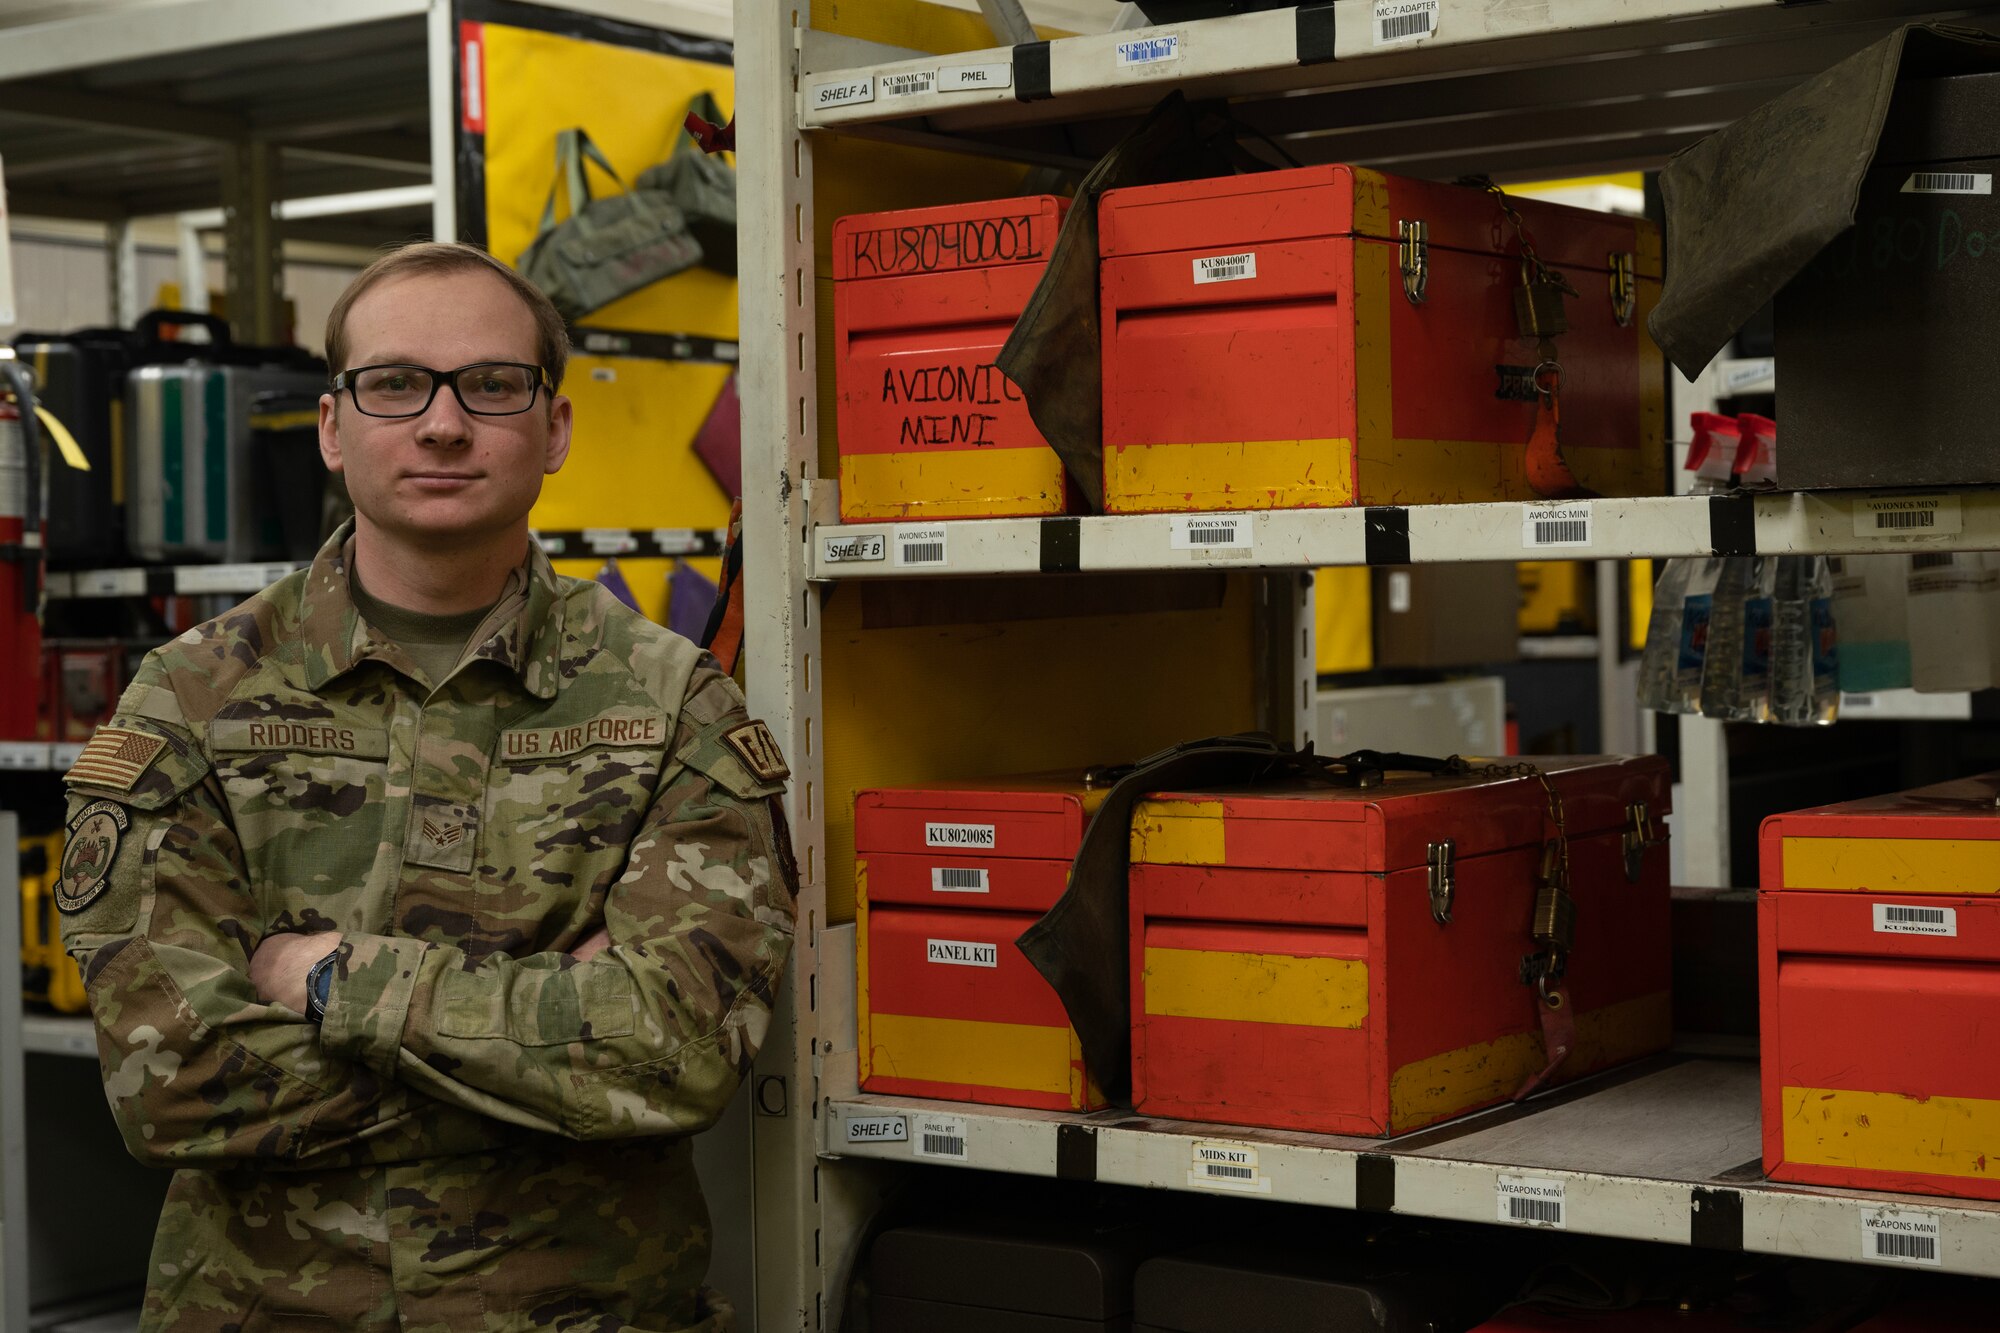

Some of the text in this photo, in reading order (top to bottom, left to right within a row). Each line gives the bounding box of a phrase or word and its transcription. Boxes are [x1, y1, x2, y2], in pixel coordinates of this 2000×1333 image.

[1376, 1, 1437, 17] MC-7 ADAPTER
[1118, 37, 1177, 54] KU80MC702
[882, 72, 935, 87] KU80MC701
[961, 71, 988, 82] PMEL
[820, 84, 869, 102] SHELF A
[854, 215, 1043, 277] KU8040001
[1201, 254, 1250, 269] KU8040007
[882, 363, 1022, 405] AVIONIC
[900, 413, 998, 447] MINI
[1872, 500, 1938, 510] AVIONICS MINI
[1529, 510, 1589, 519] AVIONICS MINI
[1187, 520, 1238, 528] AVIONICS MINI
[898, 531, 945, 540] AVIONICS MINI
[830, 543, 881, 558] SHELF B
[249, 723, 355, 751] RIDDERS
[508, 718, 657, 756] U.S. AIR FORCE
[929, 827, 994, 844] KU8020085
[929, 943, 997, 963] PANEL KIT
[851, 1122, 903, 1137] SHELF C
[924, 1123, 955, 1133] PANEL KIT
[1200, 1149, 1248, 1163] MIDS KIT
[1500, 1184, 1562, 1197] WEAPONS MINI
[1865, 1218, 1937, 1233] WEAPONS MINI
